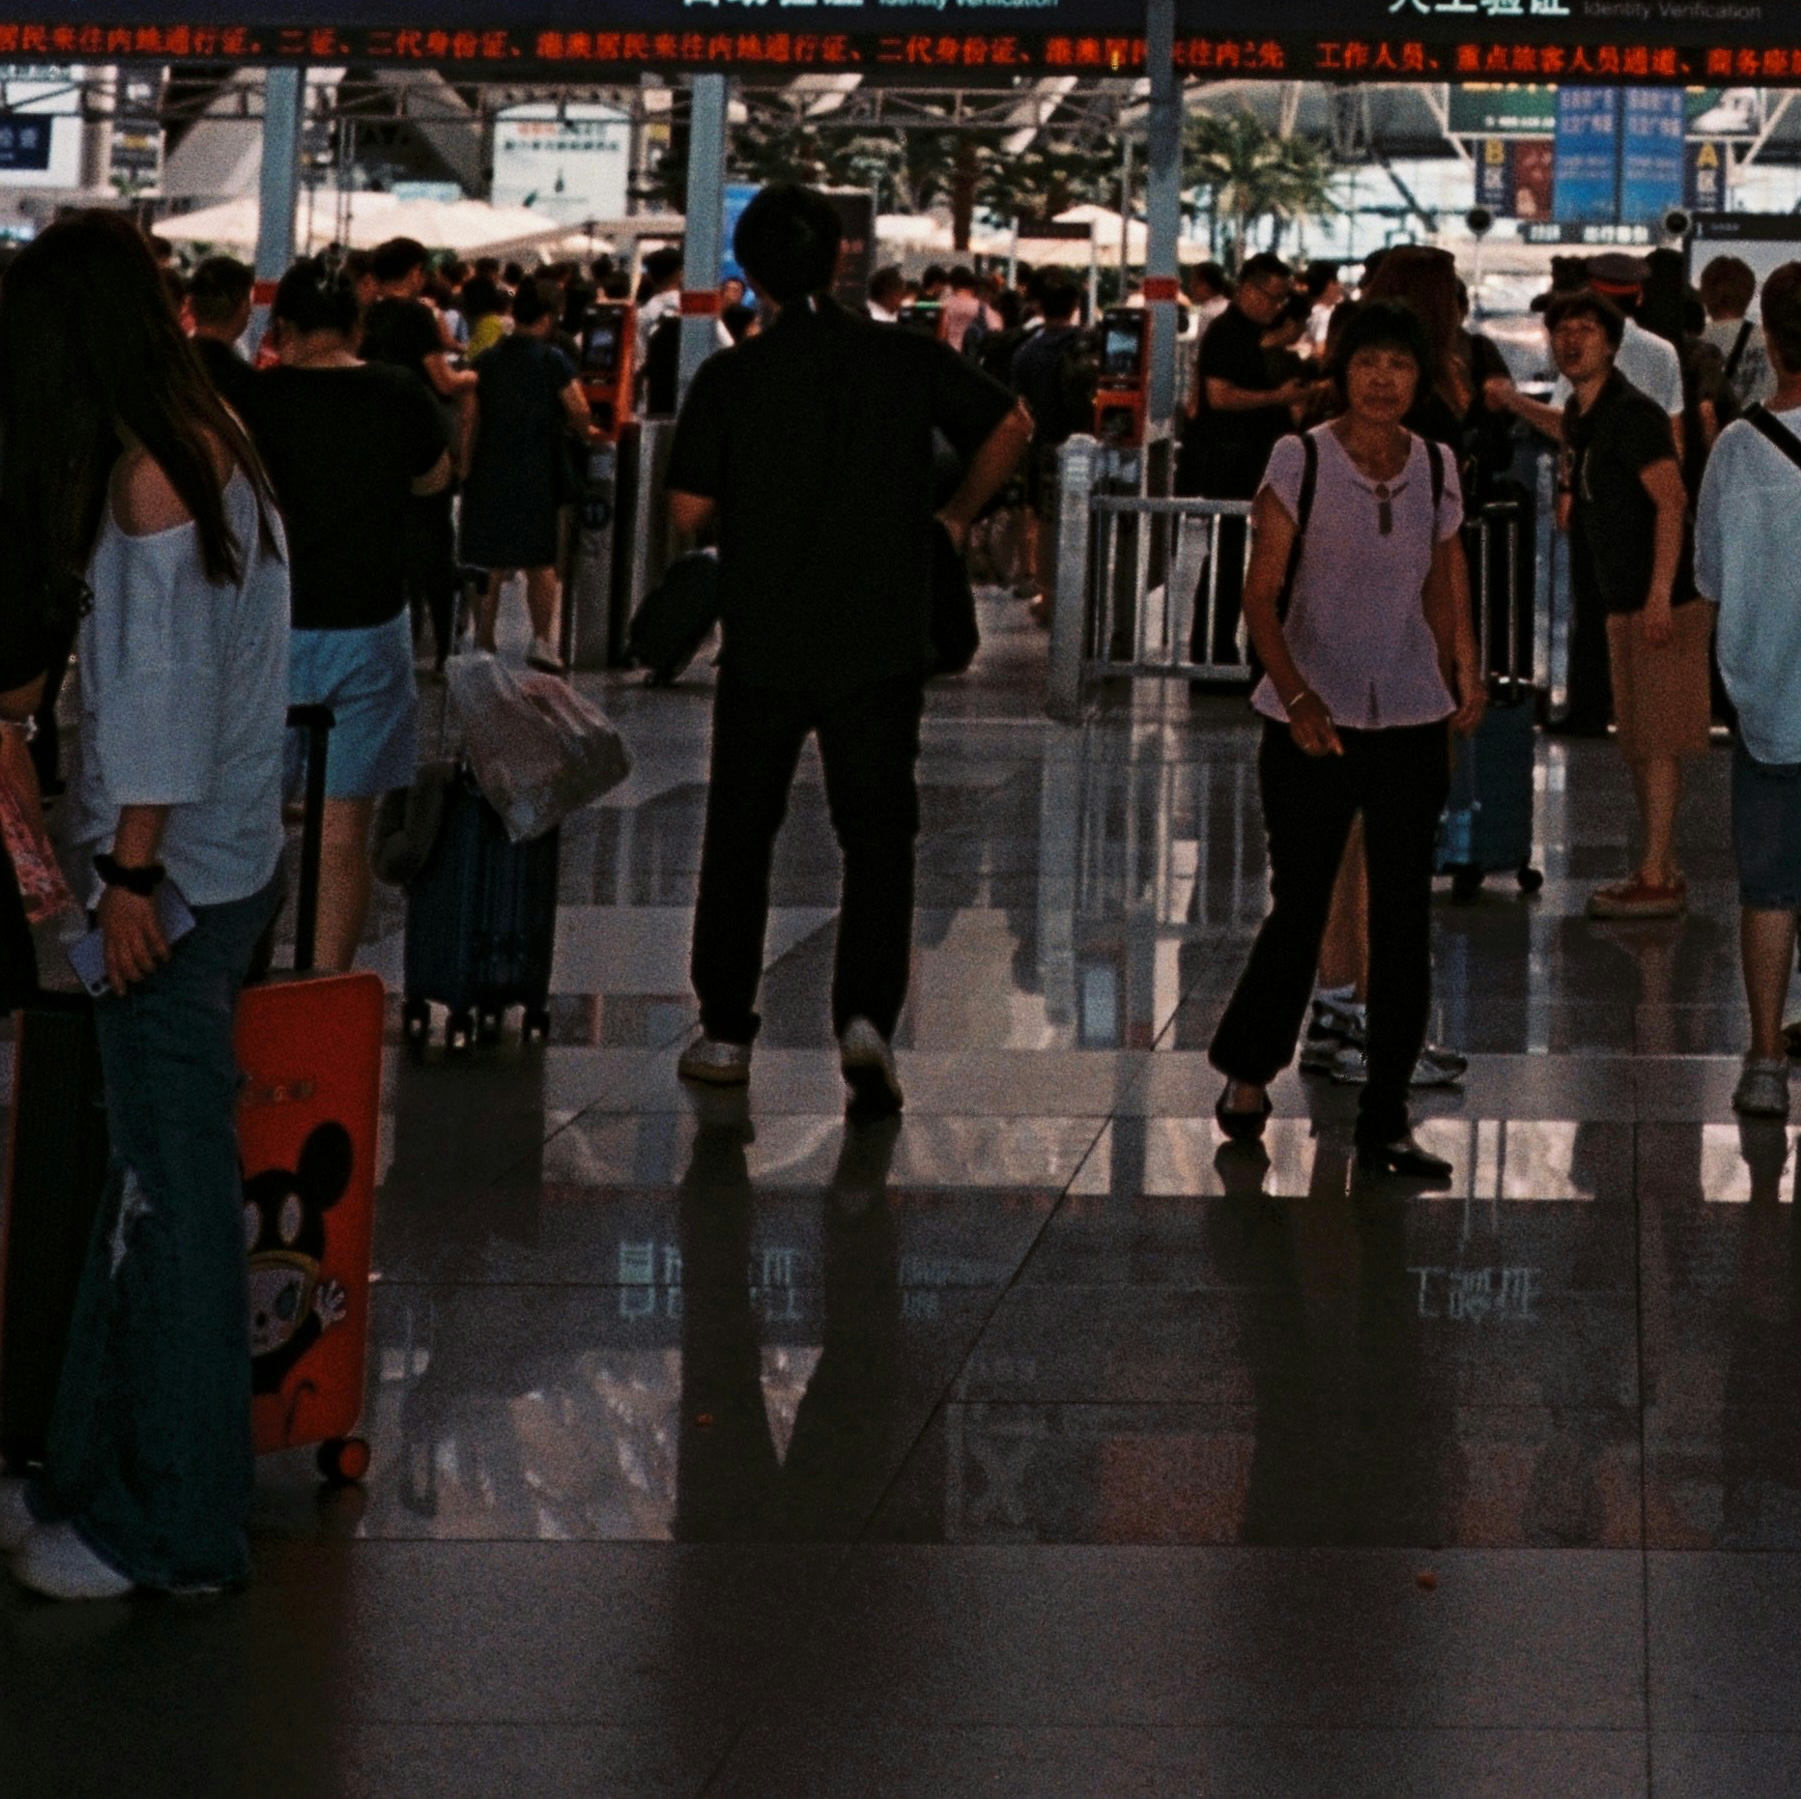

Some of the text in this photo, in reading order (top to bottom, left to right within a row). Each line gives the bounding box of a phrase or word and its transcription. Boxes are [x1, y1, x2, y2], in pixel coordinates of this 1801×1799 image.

[1584, 0, 1762, 21] Identity Verification
[1696, 143, 1719, 169] A
